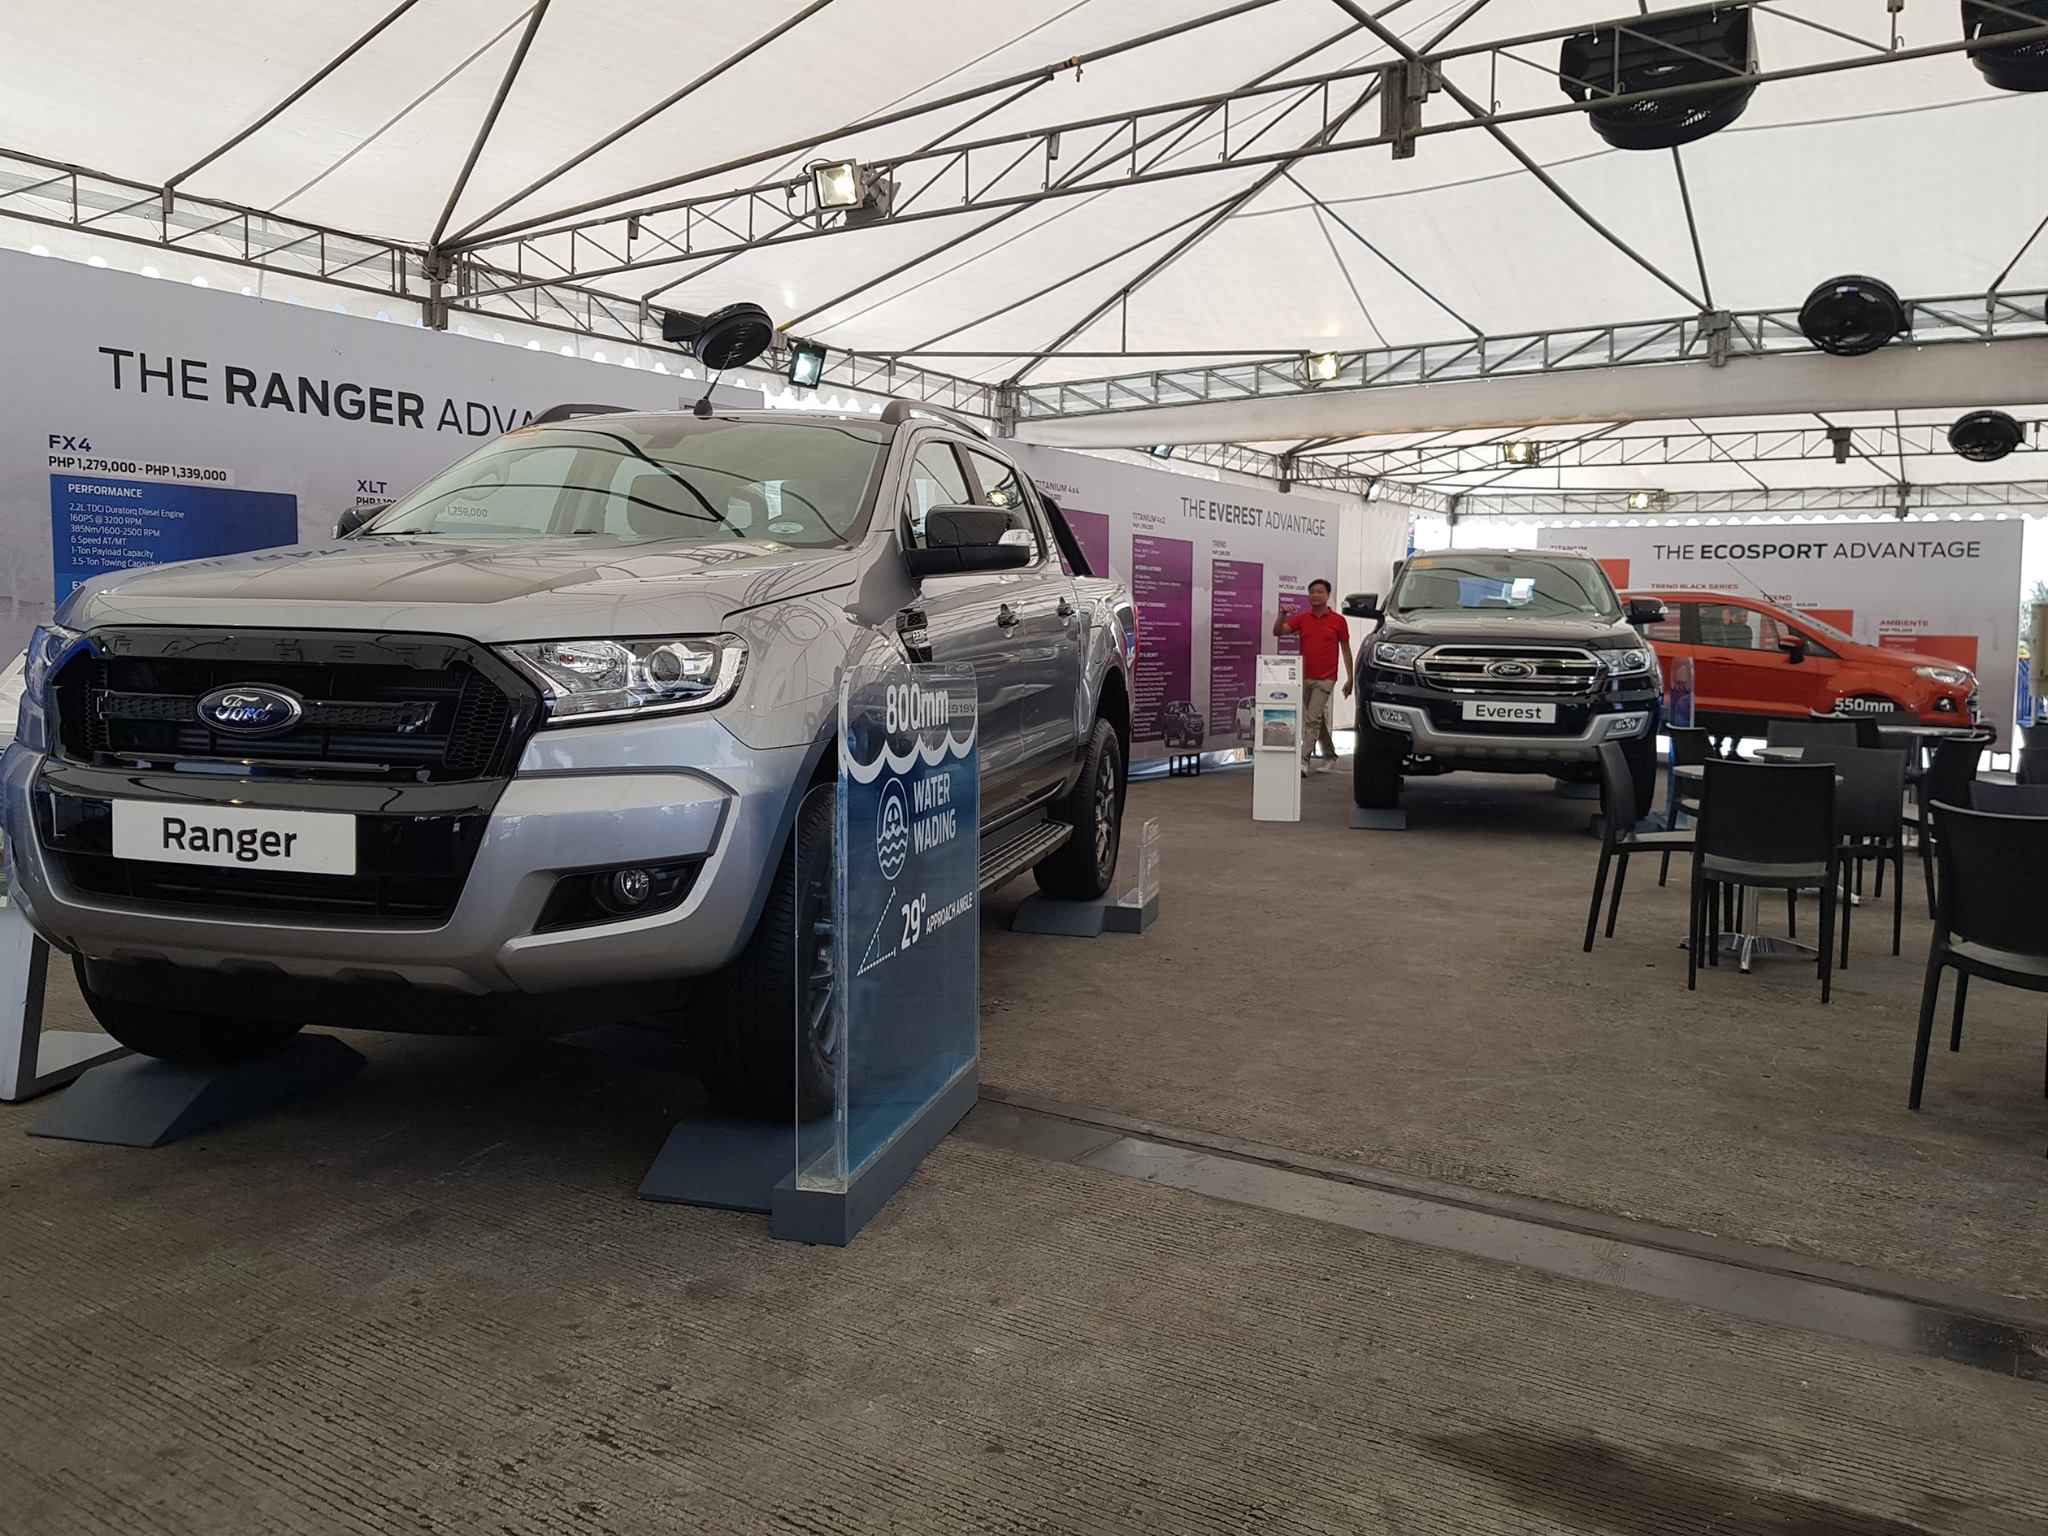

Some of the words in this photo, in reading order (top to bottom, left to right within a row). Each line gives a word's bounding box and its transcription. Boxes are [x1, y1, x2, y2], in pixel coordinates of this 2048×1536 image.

[99, 346, 208, 401] THE
[225, 365, 424, 429] RANGER
[48, 434, 92, 452] FX4
[48, 456, 75, 468] PHP
[77, 458, 136, 473] 1,279,000
[145, 464, 170, 476] PHP
[172, 467, 227, 481] 1,339,000
[68, 483, 143, 498] PERFORMANCE
[357, 479, 387, 494] XLT
[69, 503, 85, 512] 2.2L
[105, 505, 137, 516] Duratorq
[138, 508, 160, 517] Diesel
[160, 509, 185, 519] Engine
[447, 505, 488, 517] 1,259,000
[1180, 497, 1206, 519] THE
[1209, 501, 1263, 527] EVEREST
[1265, 511, 1326, 537] ADVANTAGE
[70, 514, 94, 523] 160PS
[105, 516, 124, 525] 3200
[125, 517, 142, 526] RPM
[70, 535, 77, 543] 6
[77, 536, 101, 545] Speed
[103, 537, 127, 546] AT/MT
[143, 529, 160, 537] RPM
[71, 546, 91, 555] 1-Ton
[92, 547, 121, 557] Payload
[123, 548, 154, 559] Capacity
[1653, 544, 1694, 560] THE
[1700, 543, 1828, 560] ECOSPORT
[1833, 541, 1981, 559] ADVANTAGE
[72, 557, 100, 566] 3.5-Ton
[101, 558, 127, 568] Towing
[1708, 583, 1739, 591] SERIES
[1879, 619, 1929, 627] AMBIENTE
[215, 694, 273, 722] Ford
[886, 683, 950, 734] 800mm
[1476, 704, 1542, 719] Everest
[1834, 697, 1895, 712] 550mm
[913, 772, 951, 814] WATER
[913, 808, 956, 855] WADING
[162, 817, 298, 862] Ranger
[926, 901, 956, 935] APPROACH
[956, 891, 973, 917] ANGLE
